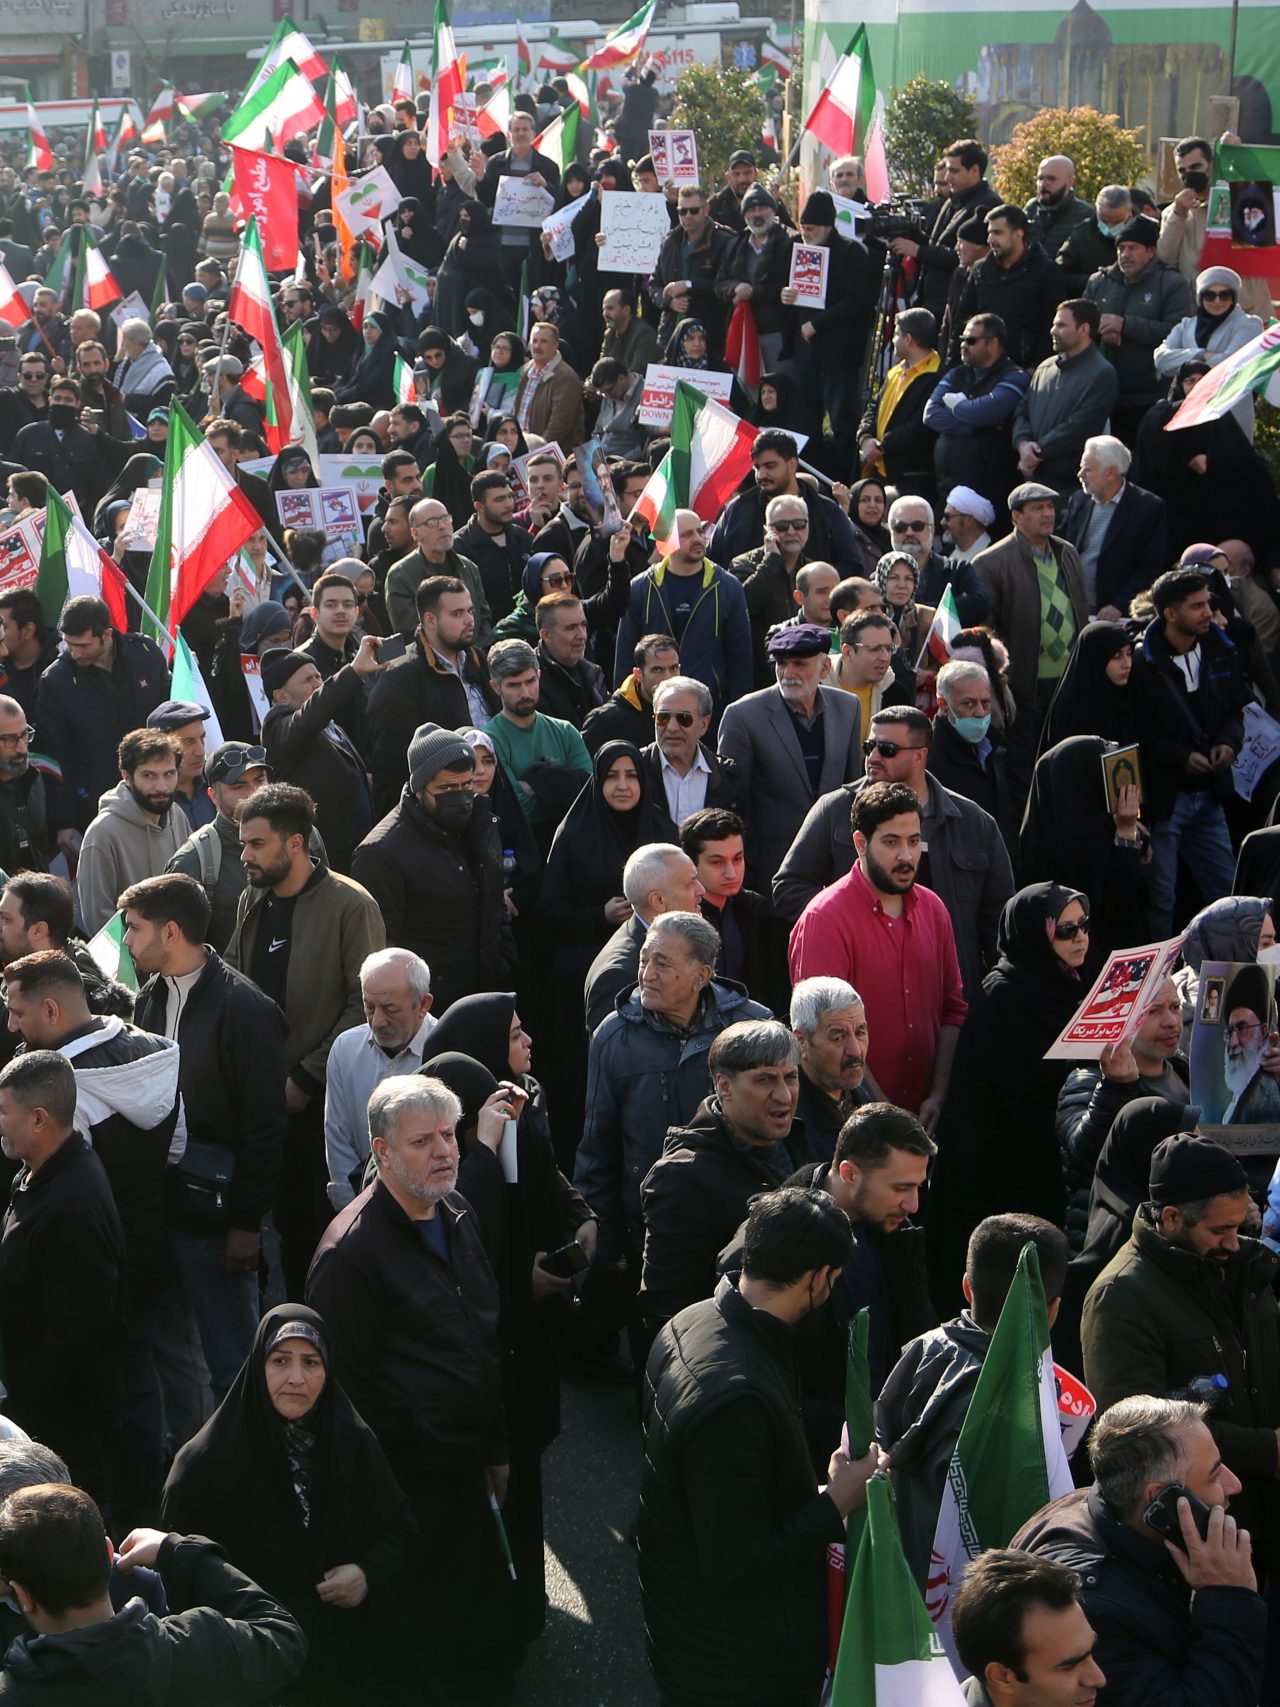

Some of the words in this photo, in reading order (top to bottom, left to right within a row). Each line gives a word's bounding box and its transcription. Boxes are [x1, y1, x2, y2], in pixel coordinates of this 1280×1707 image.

[673, 49, 694, 64] 115
[641, 410, 669, 420] DOWN
[1073, 1024, 1104, 1038] آمریکا
[1106, 1023, 1122, 1038] مرگ
